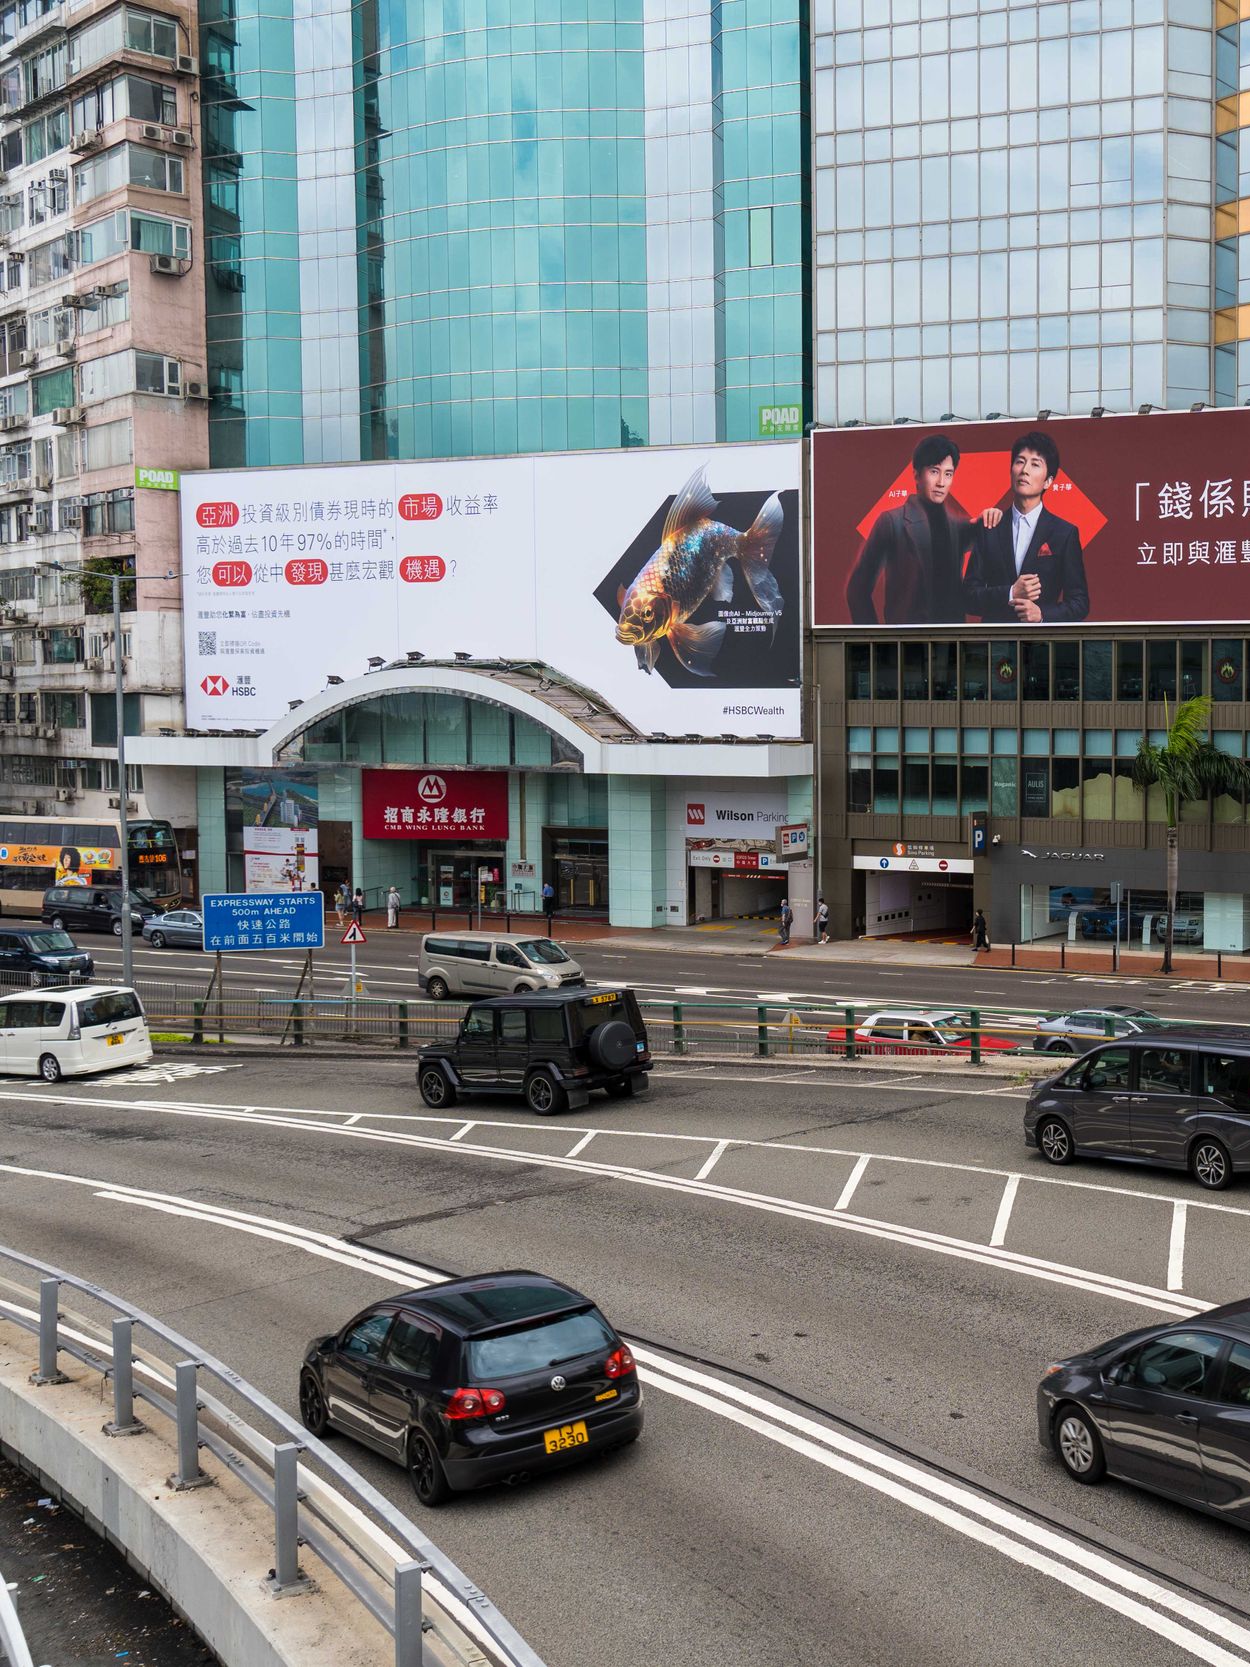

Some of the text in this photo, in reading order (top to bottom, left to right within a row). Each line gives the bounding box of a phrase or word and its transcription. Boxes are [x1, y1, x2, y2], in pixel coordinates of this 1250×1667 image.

[762, 407, 799, 425] POAD
[140, 469, 174, 484] POAD
[232, 687, 256, 696] HSBC
[722, 706, 785, 716] #HSBCWealth
[384, 806, 485, 823] 招商永隆銀行
[716, 810, 754, 821] Wilson
[975, 831, 983, 848] P
[1040, 852, 1104, 862] JAGUAR
[210, 899, 274, 907] EXPRESSWAY
[238, 919, 290, 930] 快速公路
[210, 932, 318, 946] 在前面五百米開始
[550, 1432, 584, 1451] 3230
